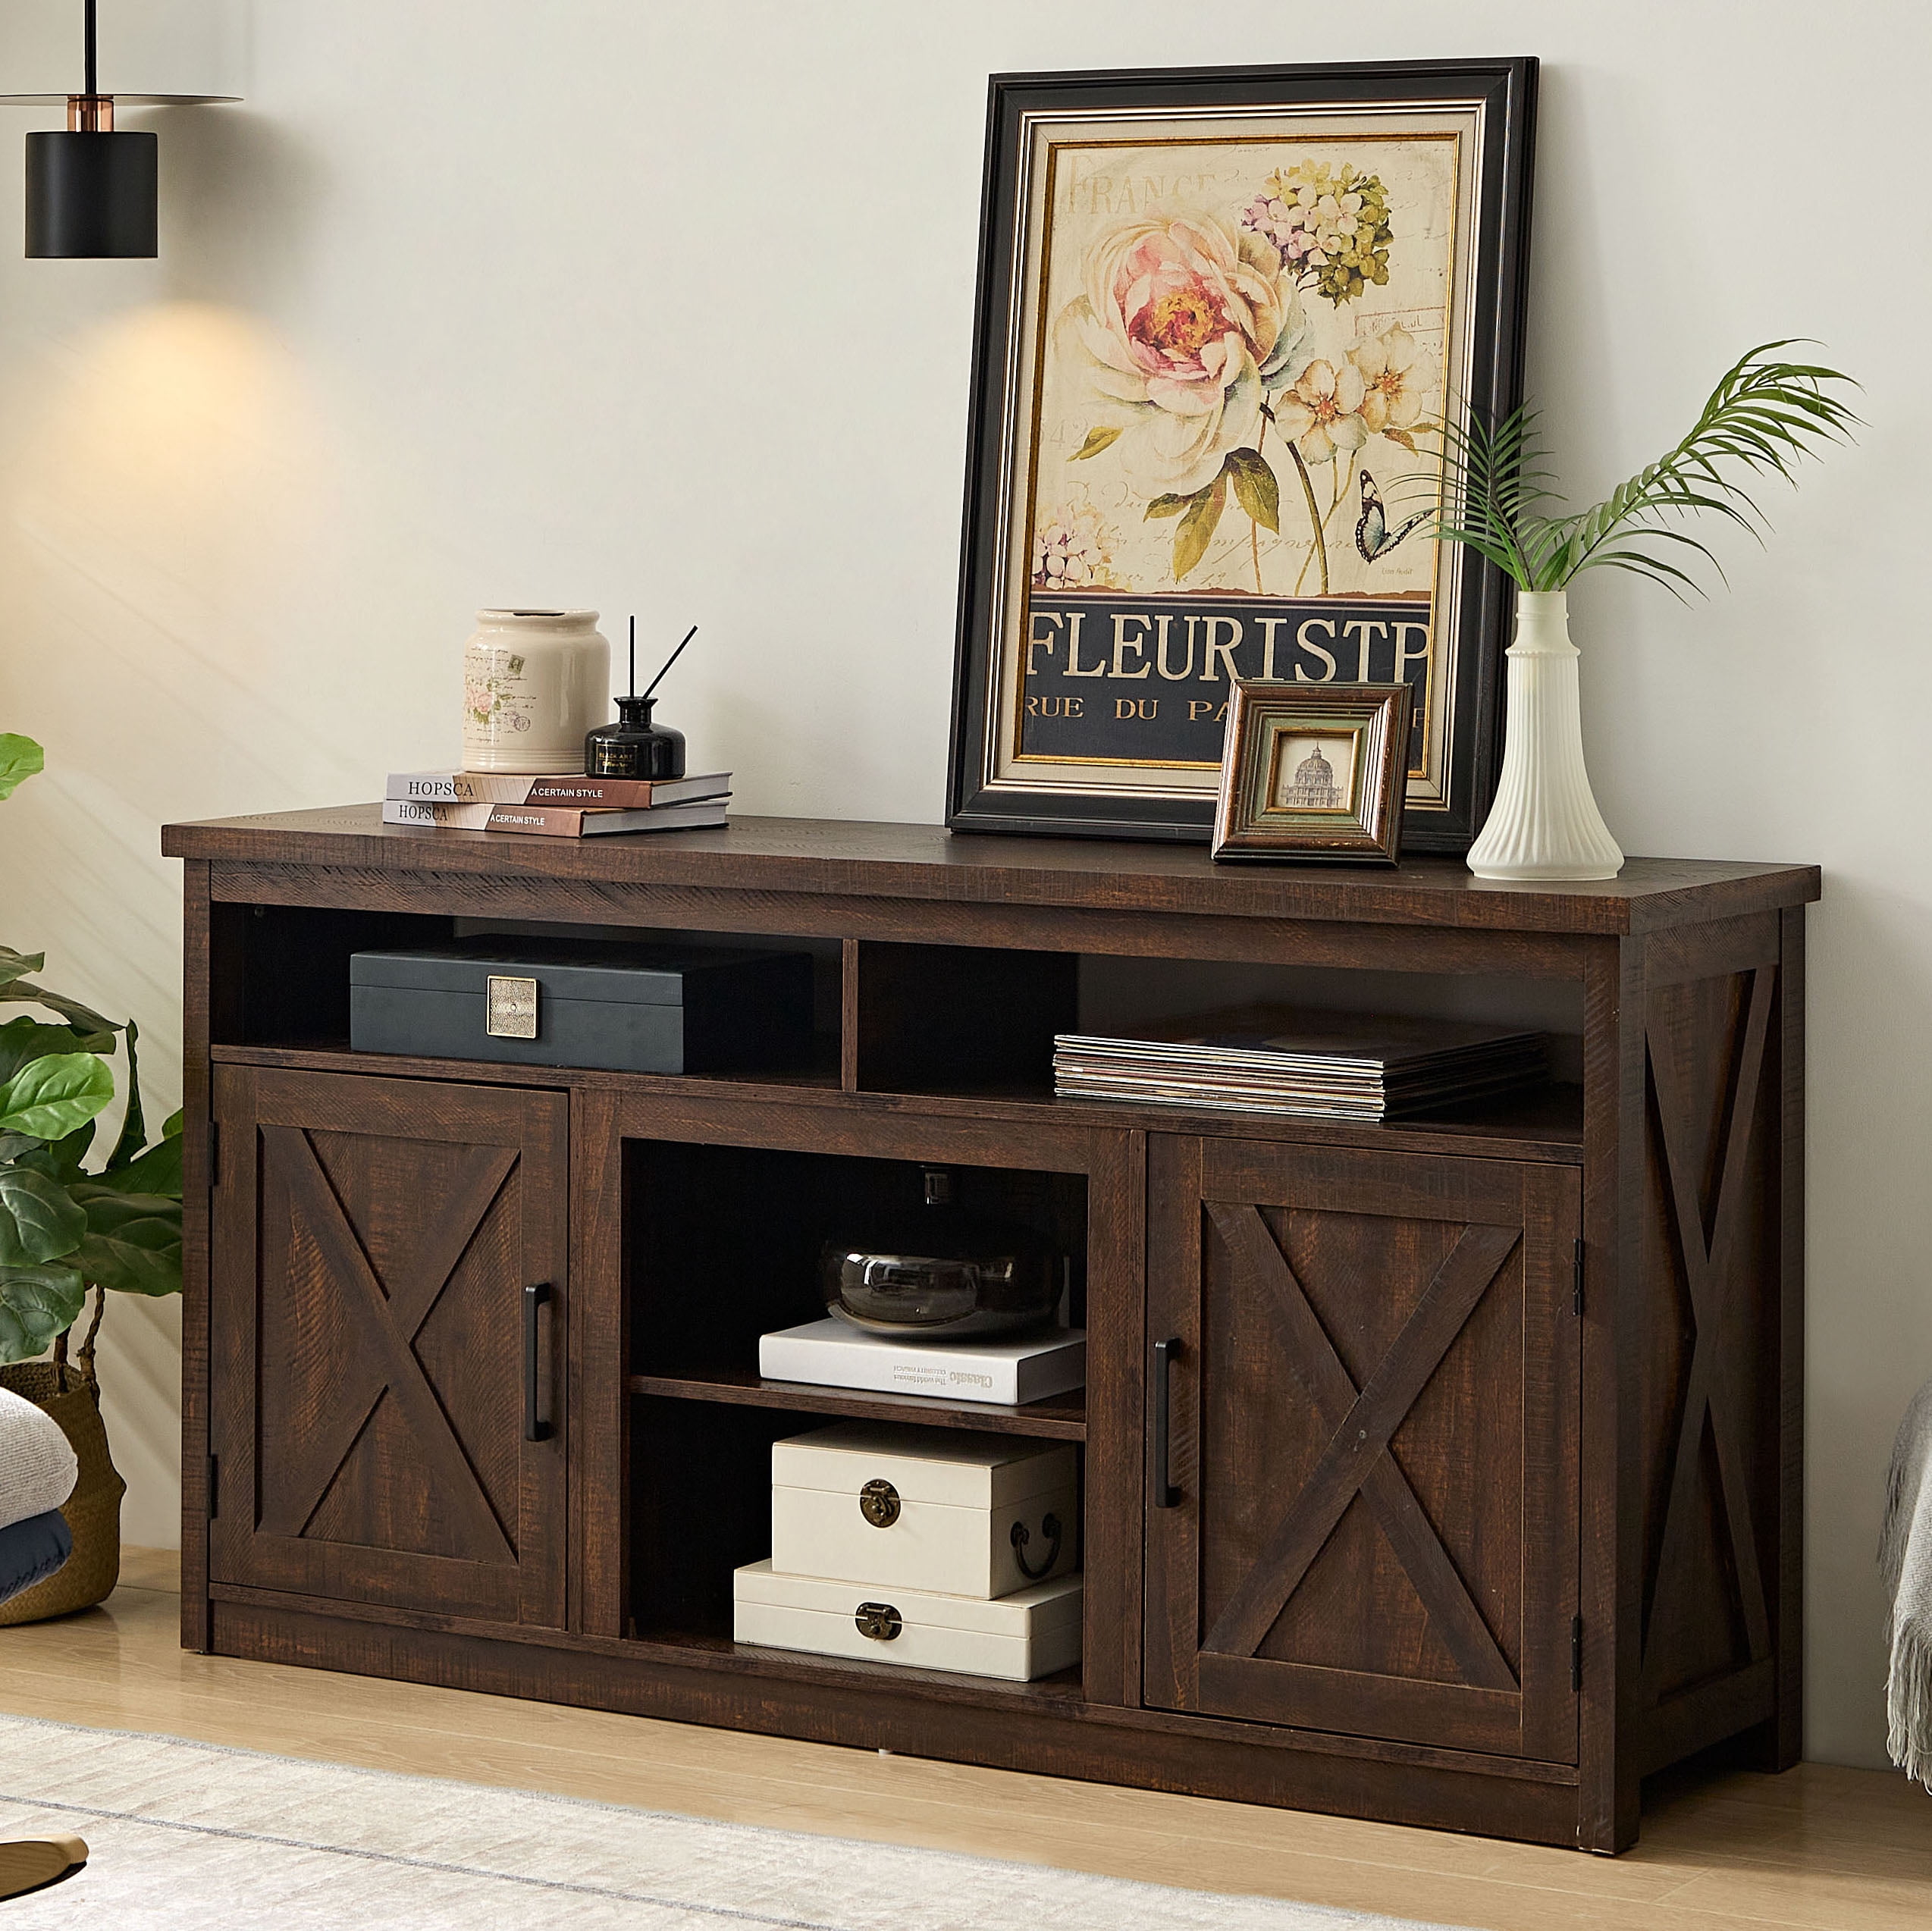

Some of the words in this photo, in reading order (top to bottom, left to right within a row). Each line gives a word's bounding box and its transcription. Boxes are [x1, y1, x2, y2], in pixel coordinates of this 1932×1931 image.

[1024, 696, 1084, 719] RUE
[1114, 698, 1159, 721] DU
[1187, 700, 1229, 722] PA
[408, 781, 475, 797] HOPSCA
[531, 788, 538, 796] A
[538, 788, 574, 797] CERTAIN
[576, 789, 604, 798] STYLE
[399, 804, 448, 821] HOPSCA
[496, 815, 523, 824] CERTAIN
[524, 816, 545, 826] STYLE
